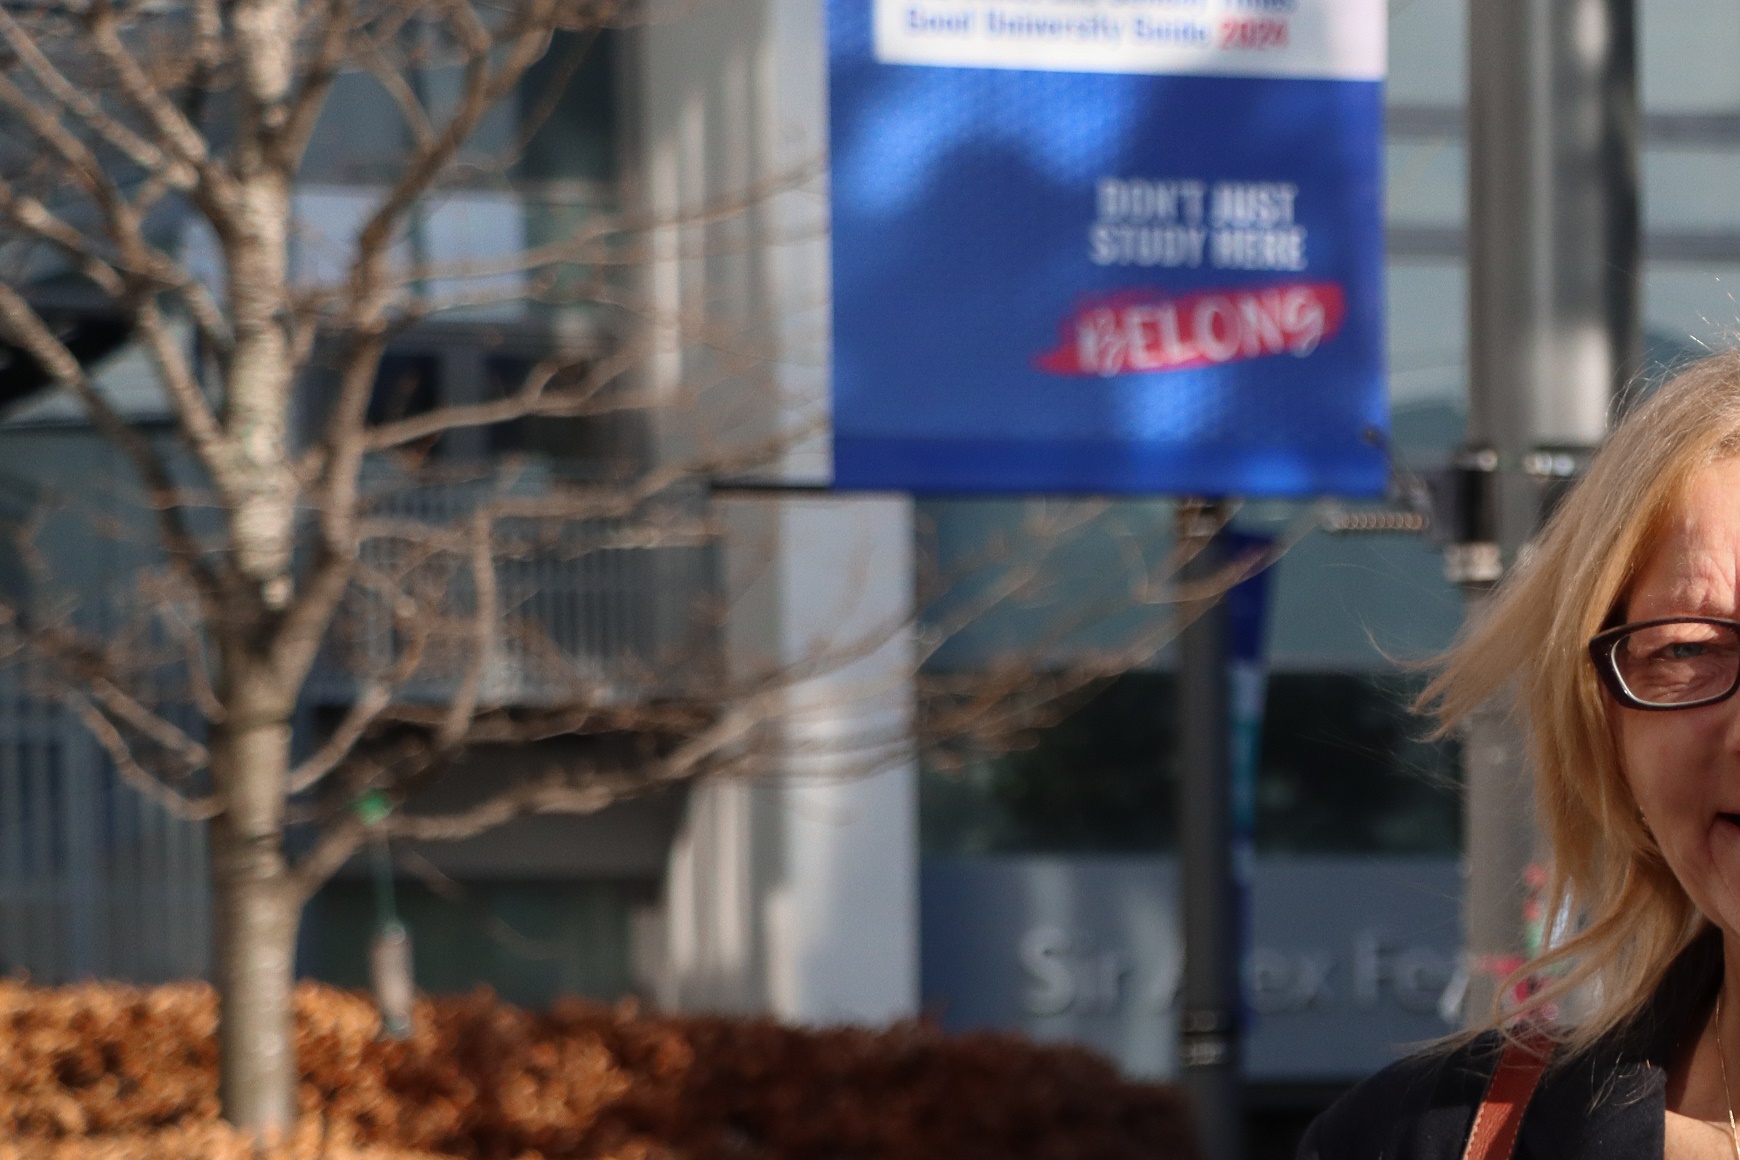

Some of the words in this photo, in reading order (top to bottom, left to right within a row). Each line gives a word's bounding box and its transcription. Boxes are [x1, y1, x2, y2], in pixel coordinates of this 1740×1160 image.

[1091, 224, 1204, 266] STUDY
[1212, 226, 1305, 270] HERE
[1078, 286, 1326, 376] BELONG
